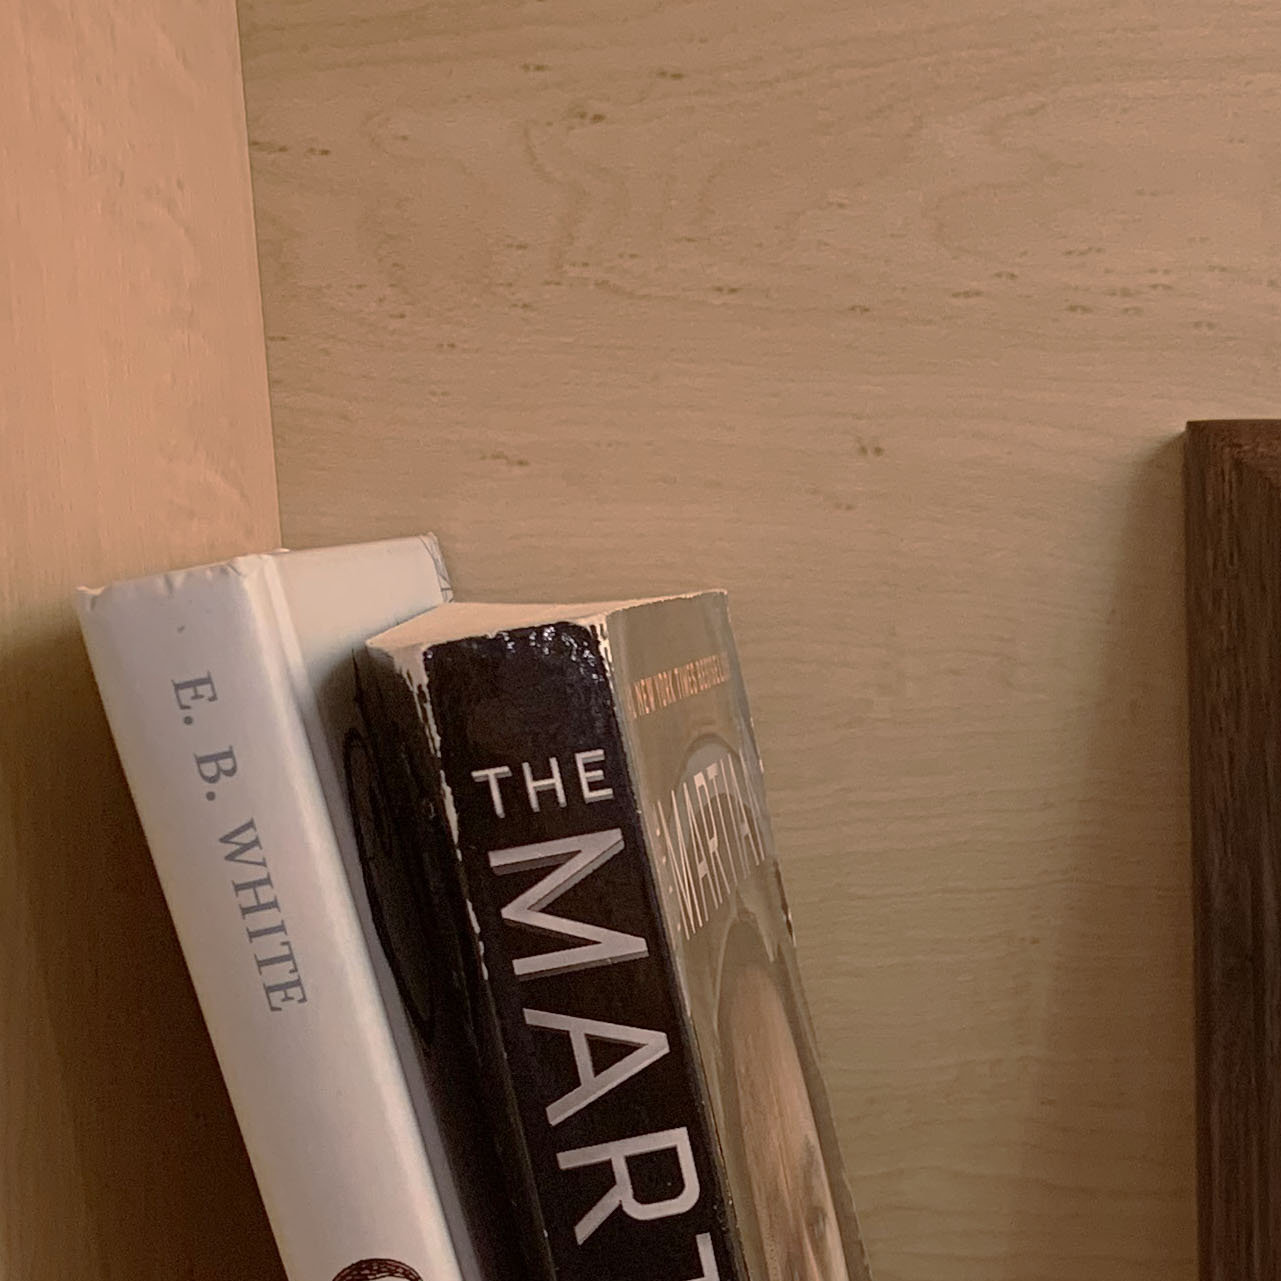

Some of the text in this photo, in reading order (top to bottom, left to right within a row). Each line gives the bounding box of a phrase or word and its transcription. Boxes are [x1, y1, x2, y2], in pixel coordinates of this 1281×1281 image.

[171, 671, 308, 1013] E. B. WHITE
[471, 748, 614, 819] THE
